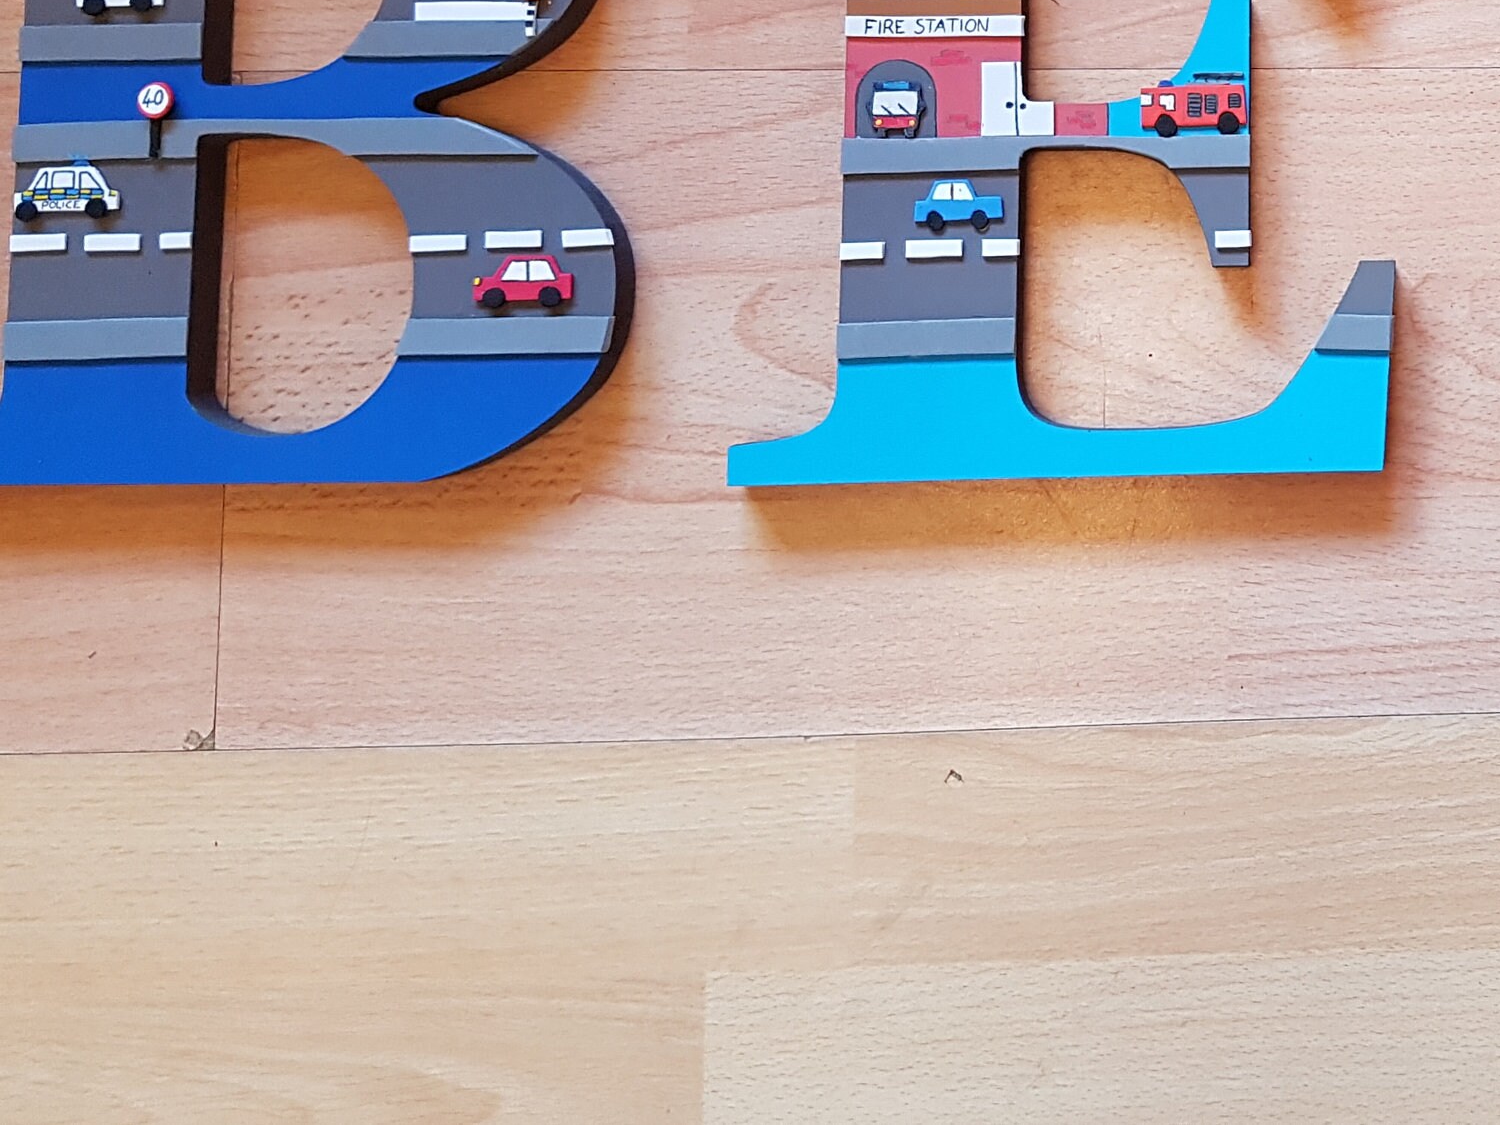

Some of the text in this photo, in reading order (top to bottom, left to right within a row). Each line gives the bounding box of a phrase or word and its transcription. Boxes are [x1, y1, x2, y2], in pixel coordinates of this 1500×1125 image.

[864, 17, 990, 35] FIRE STATION
[142, 88, 165, 108] 40
[41, 200, 82, 210] POLICE
